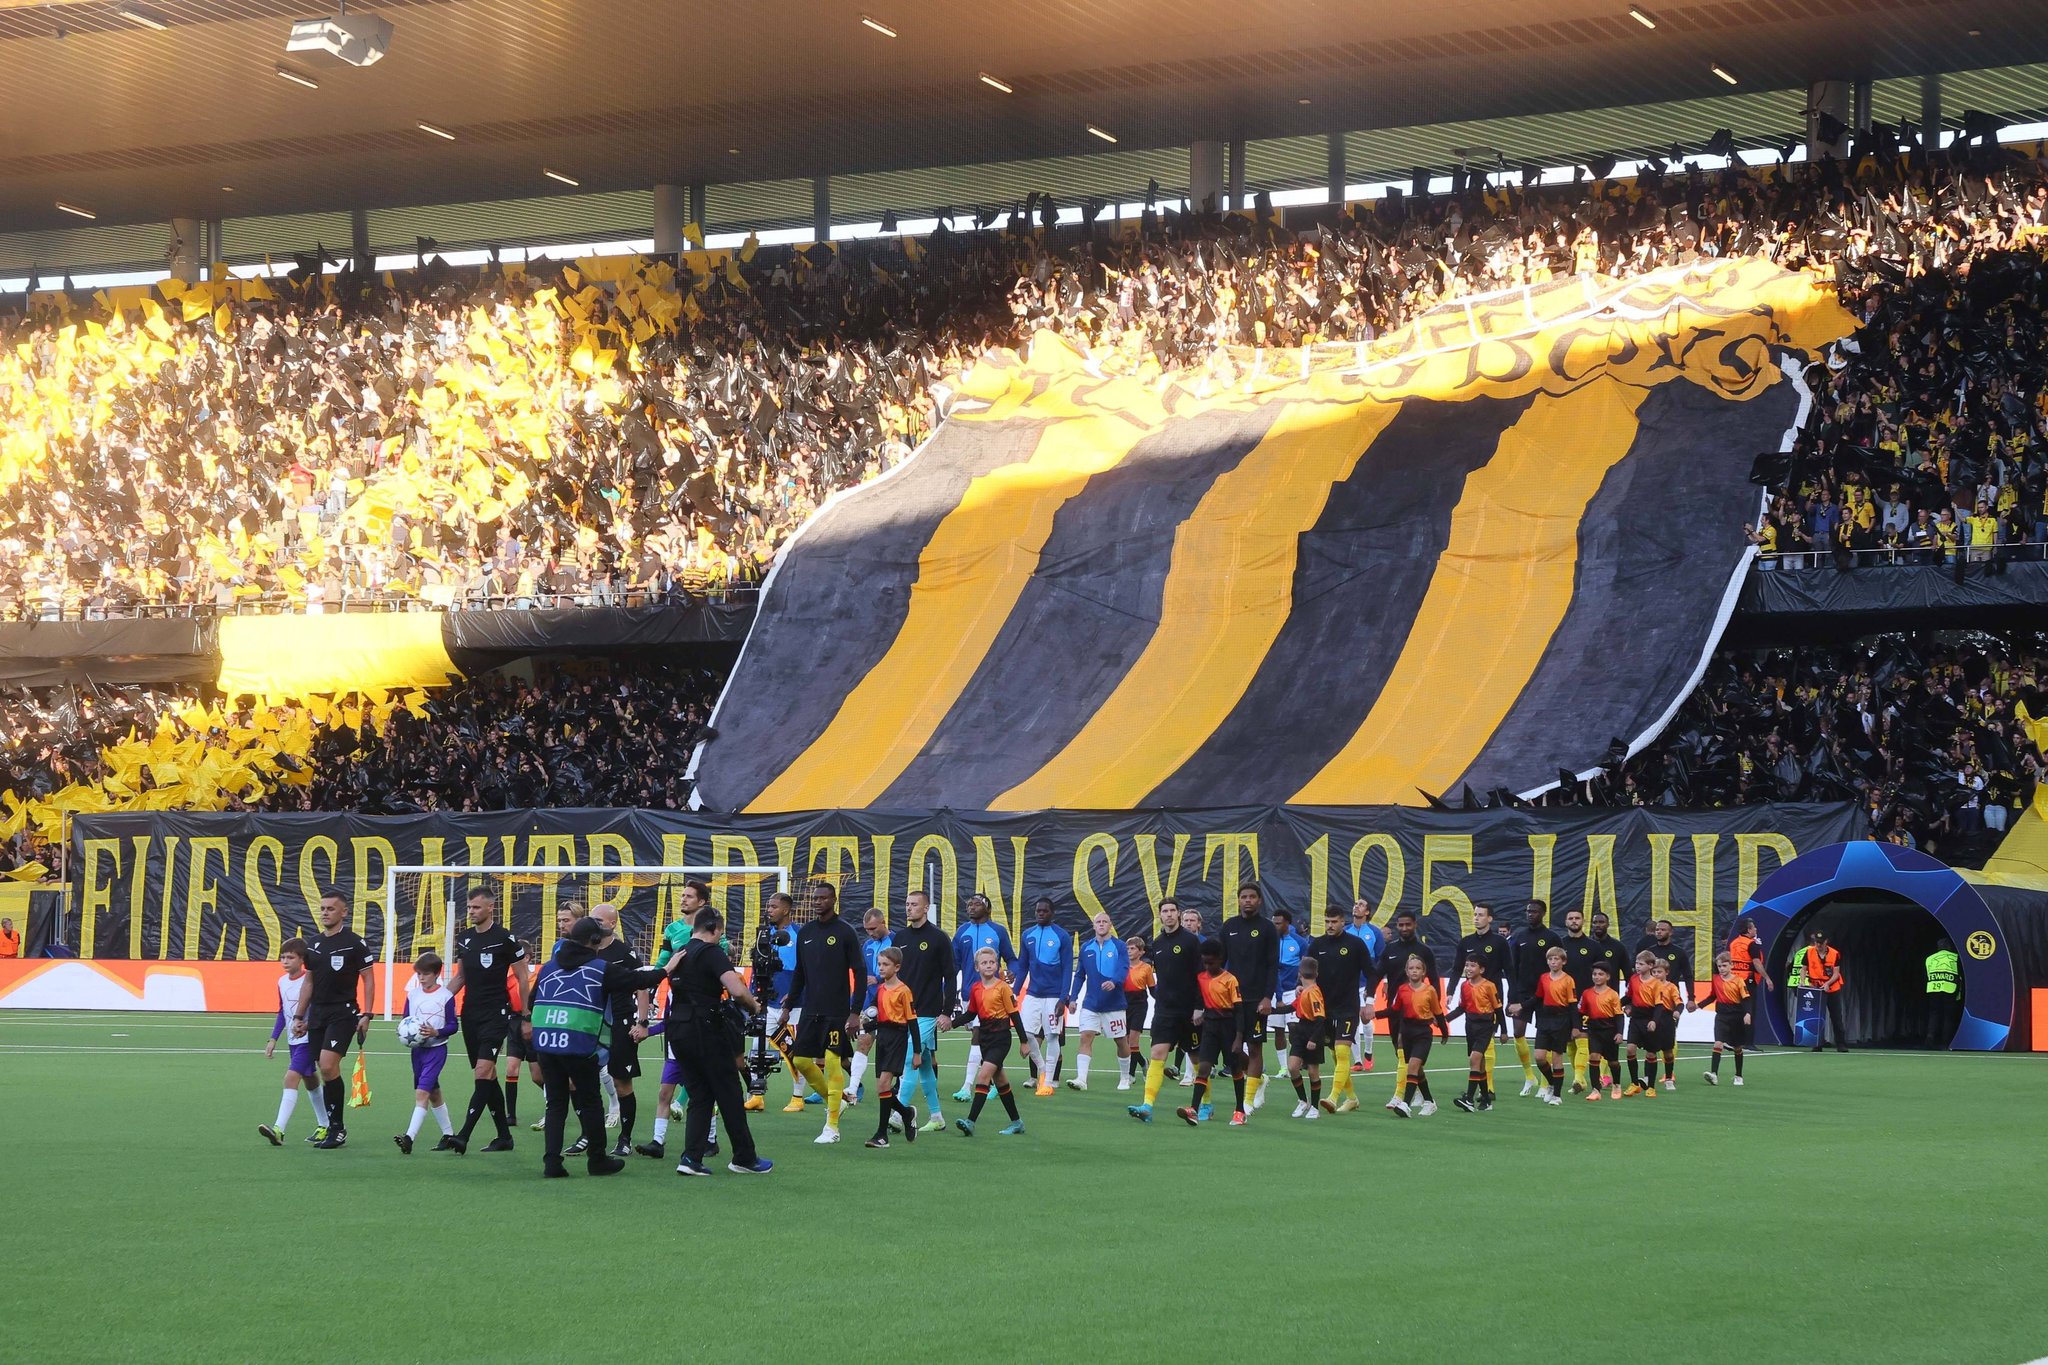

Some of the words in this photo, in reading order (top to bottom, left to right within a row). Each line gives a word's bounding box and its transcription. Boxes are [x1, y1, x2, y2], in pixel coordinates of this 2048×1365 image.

[1073, 832, 1259, 965] SYT
[1304, 833, 1477, 941] 125
[545, 1009, 569, 1025] HB
[1109, 1019, 1125, 1033] 24
[1254, 1020, 1261, 1034] 4
[1345, 1021, 1352, 1034] 7
[538, 1031, 570, 1048] 018
[828, 1030, 840, 1046] 13
